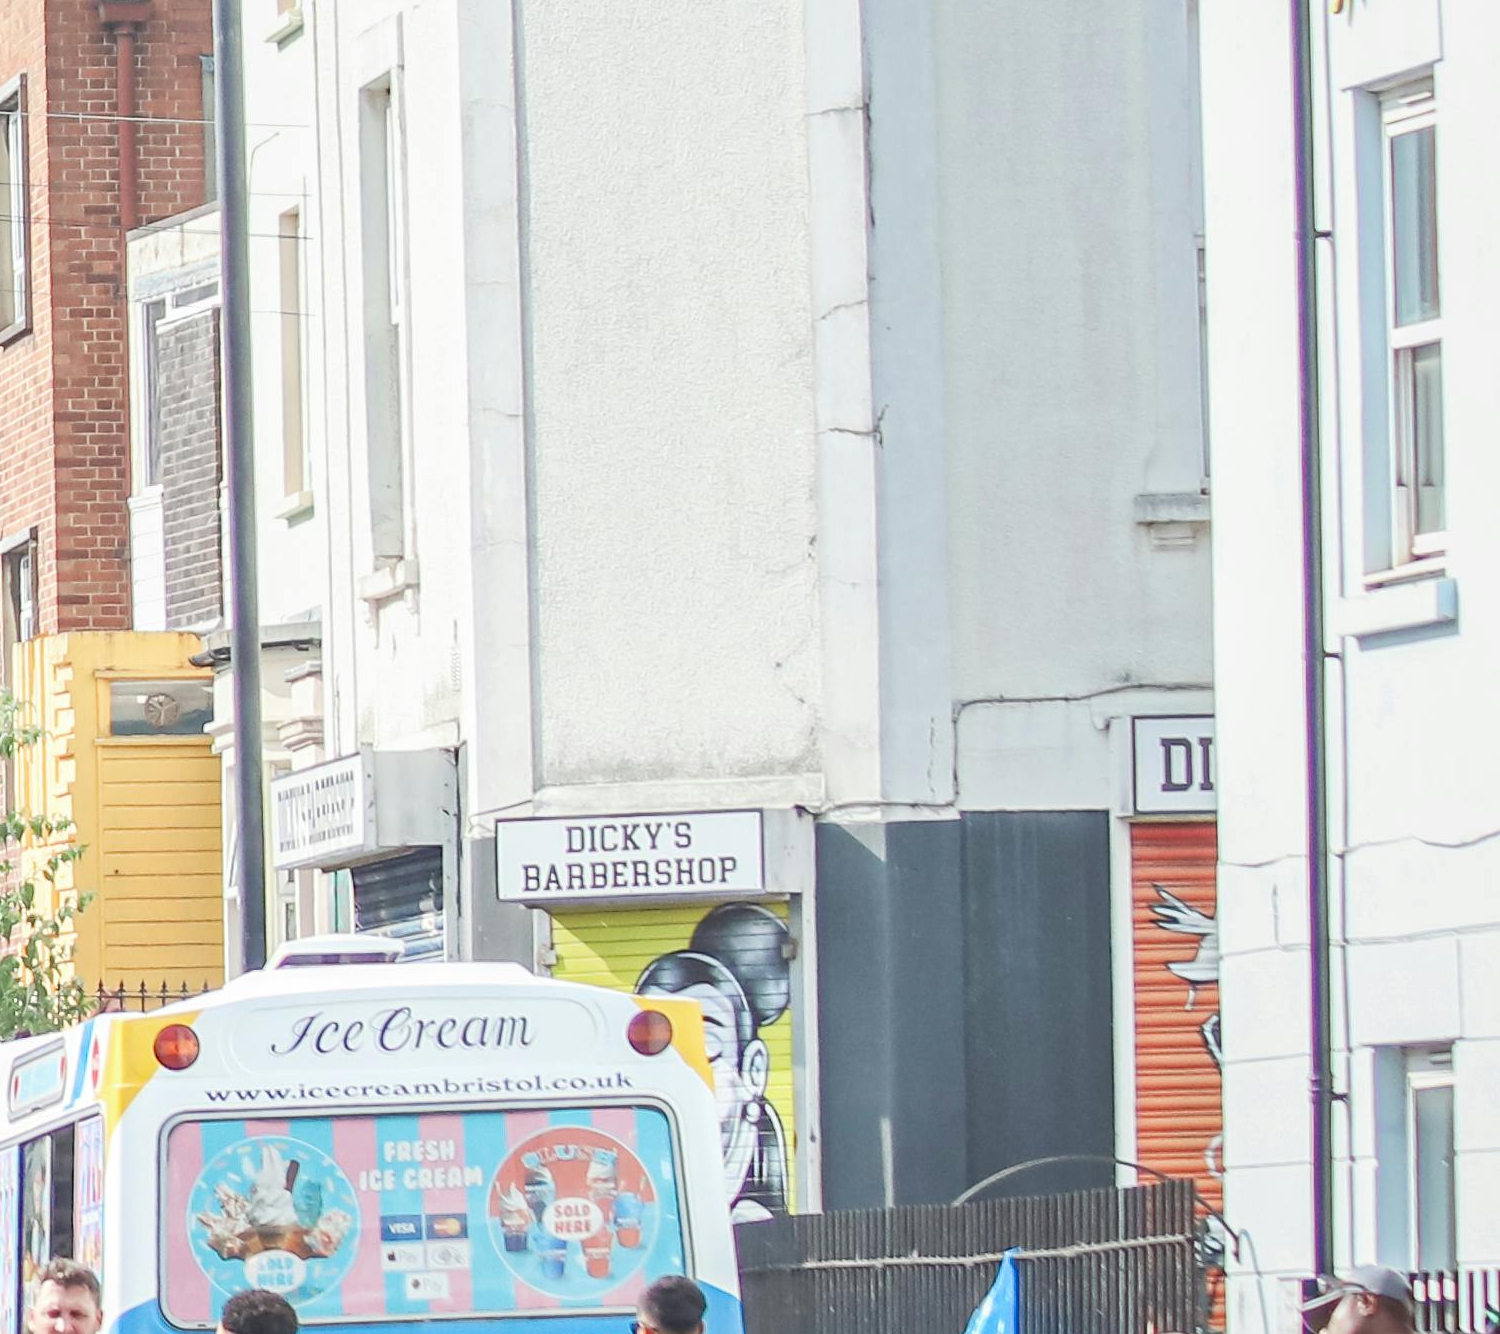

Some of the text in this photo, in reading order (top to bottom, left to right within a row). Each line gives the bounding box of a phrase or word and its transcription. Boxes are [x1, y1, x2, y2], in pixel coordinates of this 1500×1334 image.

[565, 821, 692, 854] DICKY'S
[522, 856, 737, 892] BARBERSHOP
[269, 1006, 533, 1055] Ice Cream
[206, 1072, 633, 1103] www.icecreambristol.co.uk
[383, 1141, 457, 1163] FRESH
[358, 1166, 483, 1192] ICE CREAM
[555, 1204, 591, 1218] SOLD
[388, 1222, 417, 1235] VISA
[554, 1220, 592, 1234] HERE
